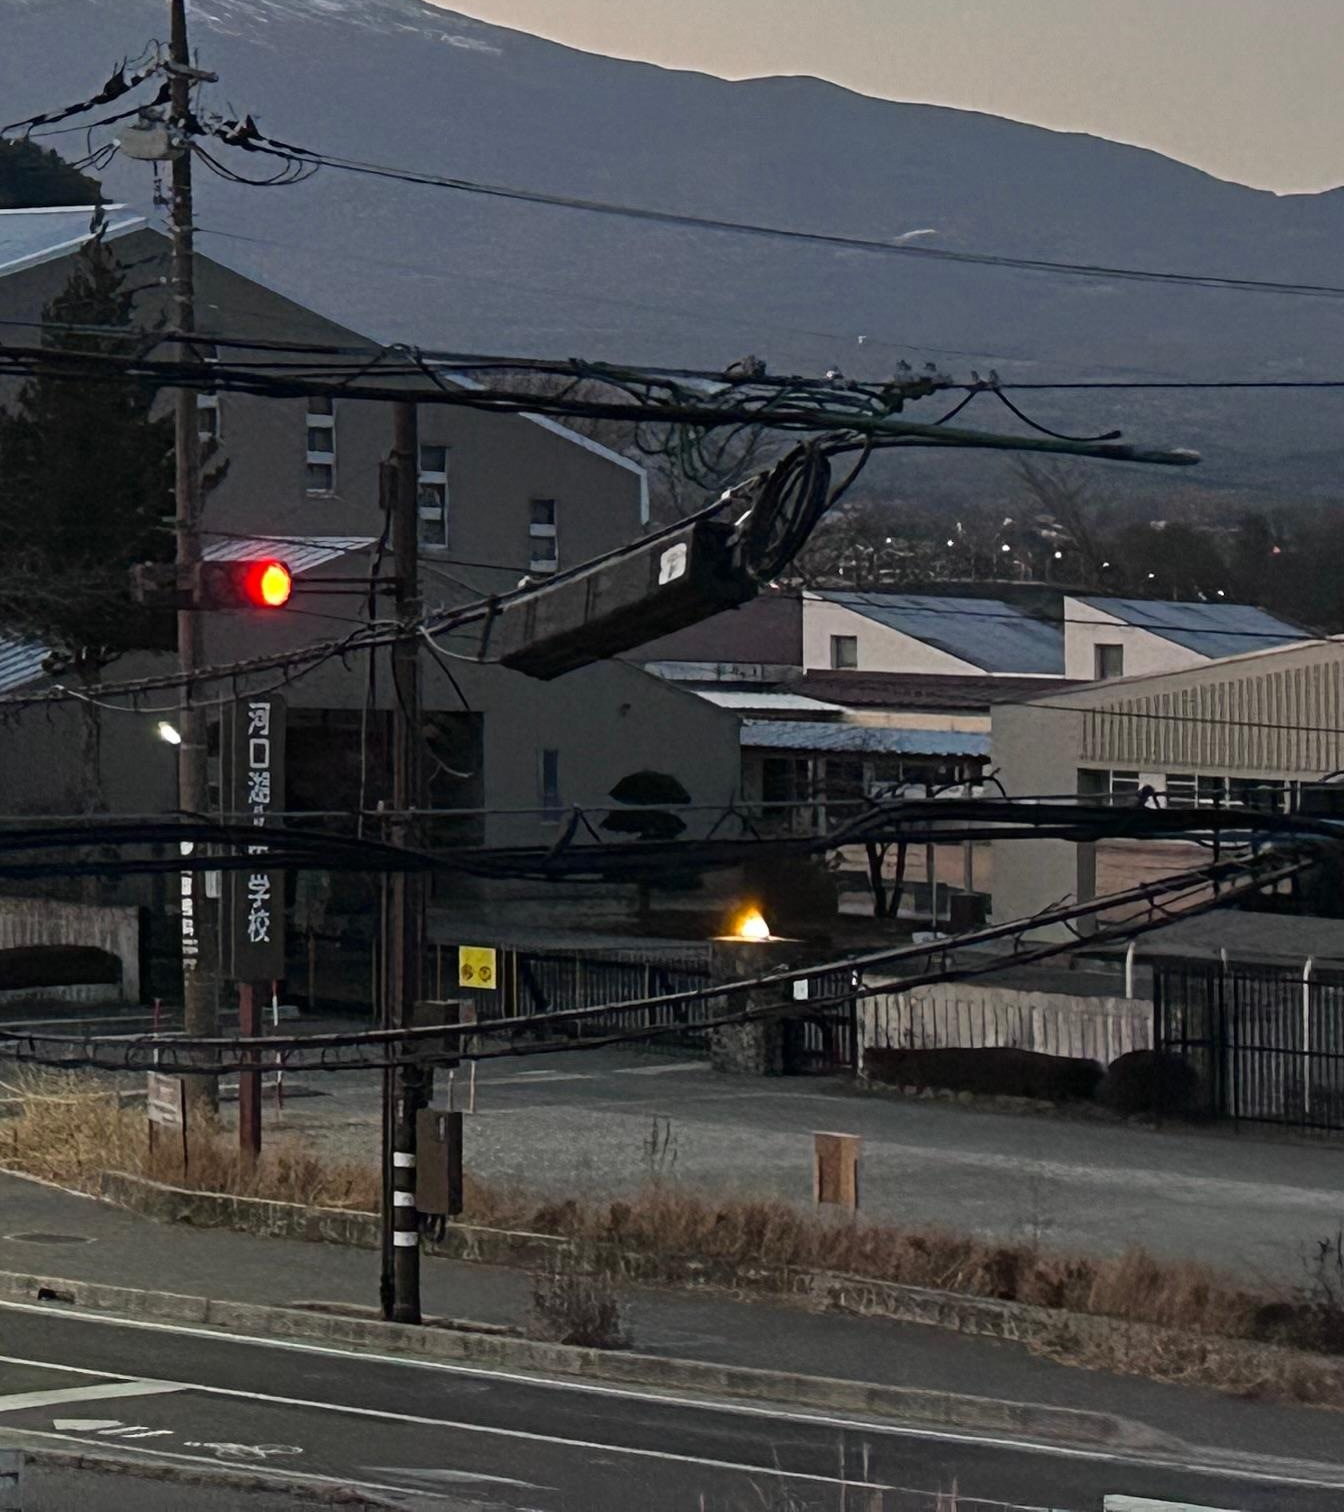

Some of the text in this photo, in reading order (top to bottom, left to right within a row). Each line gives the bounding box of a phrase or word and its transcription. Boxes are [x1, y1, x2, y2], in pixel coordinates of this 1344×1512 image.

[247, 701, 270, 943] 河口湖学校
